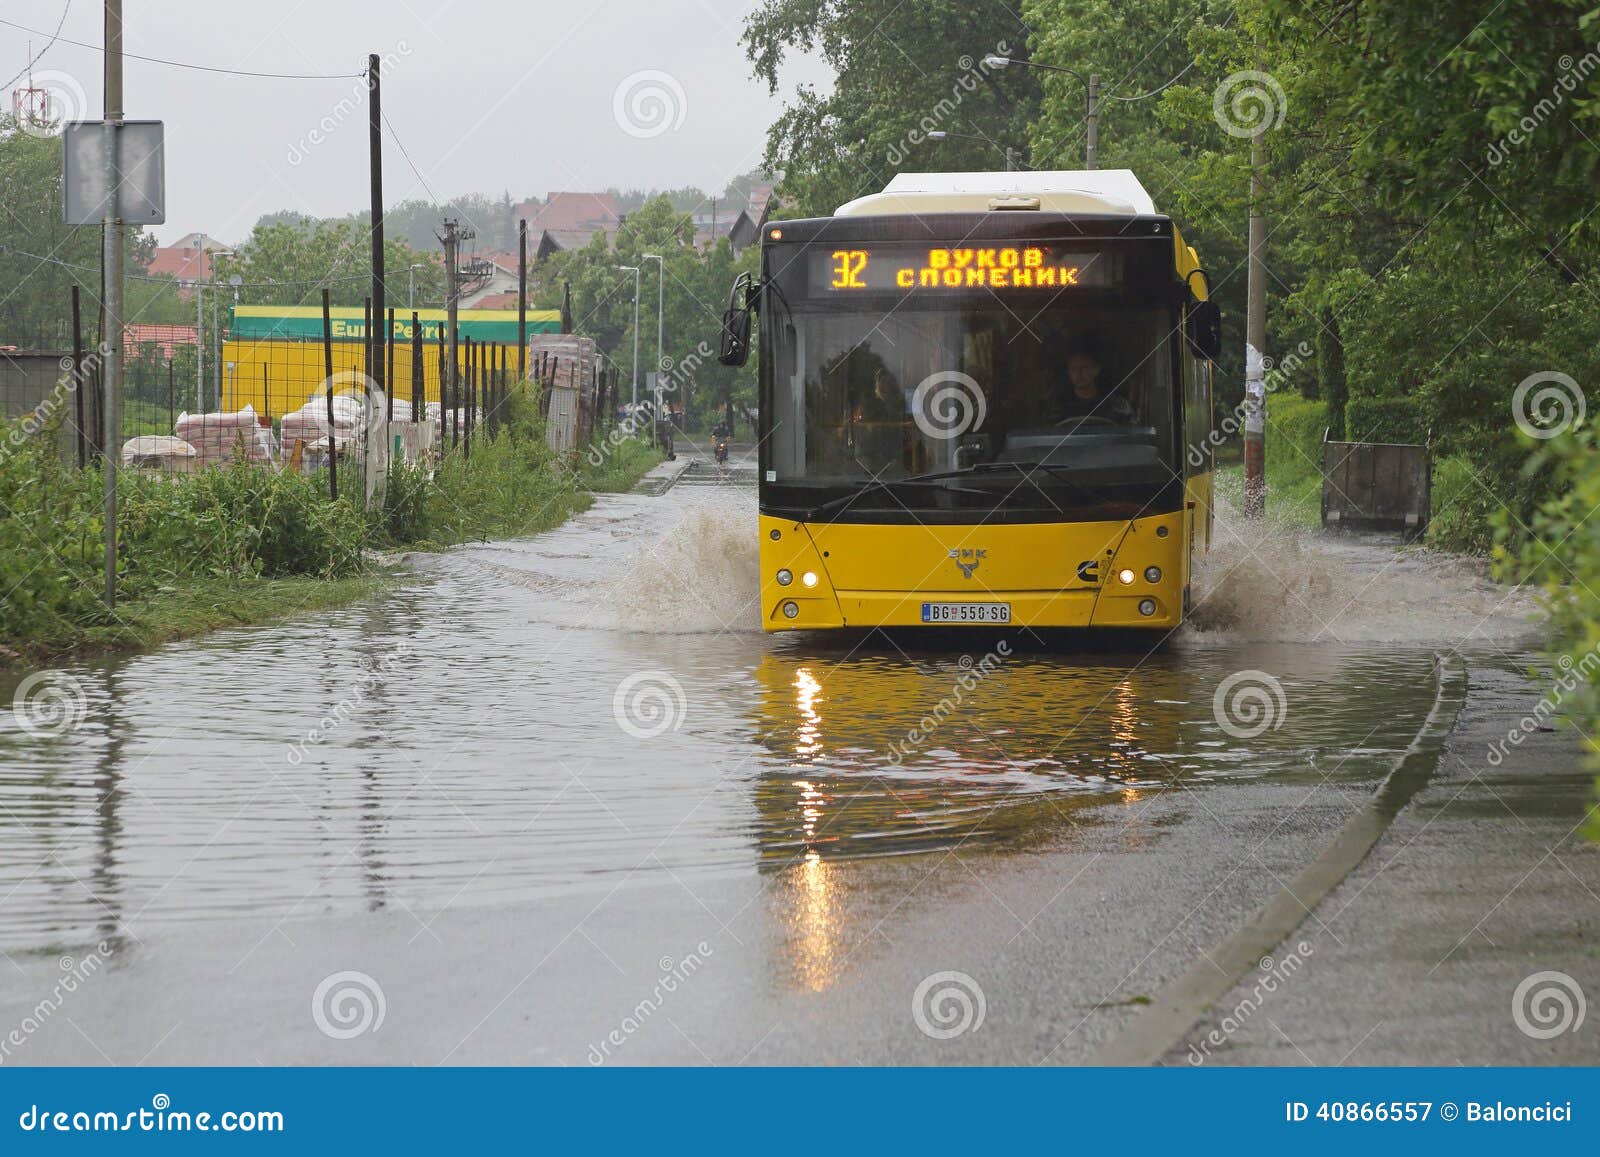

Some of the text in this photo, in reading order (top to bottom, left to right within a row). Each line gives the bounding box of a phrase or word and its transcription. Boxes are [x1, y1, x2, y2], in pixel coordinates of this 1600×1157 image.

[929, 248, 1043, 269] ВУКОВ
[832, 250, 867, 288] 32
[896, 267, 1078, 287] СПОМЕНИК
[932, 606, 949, 620] BG
